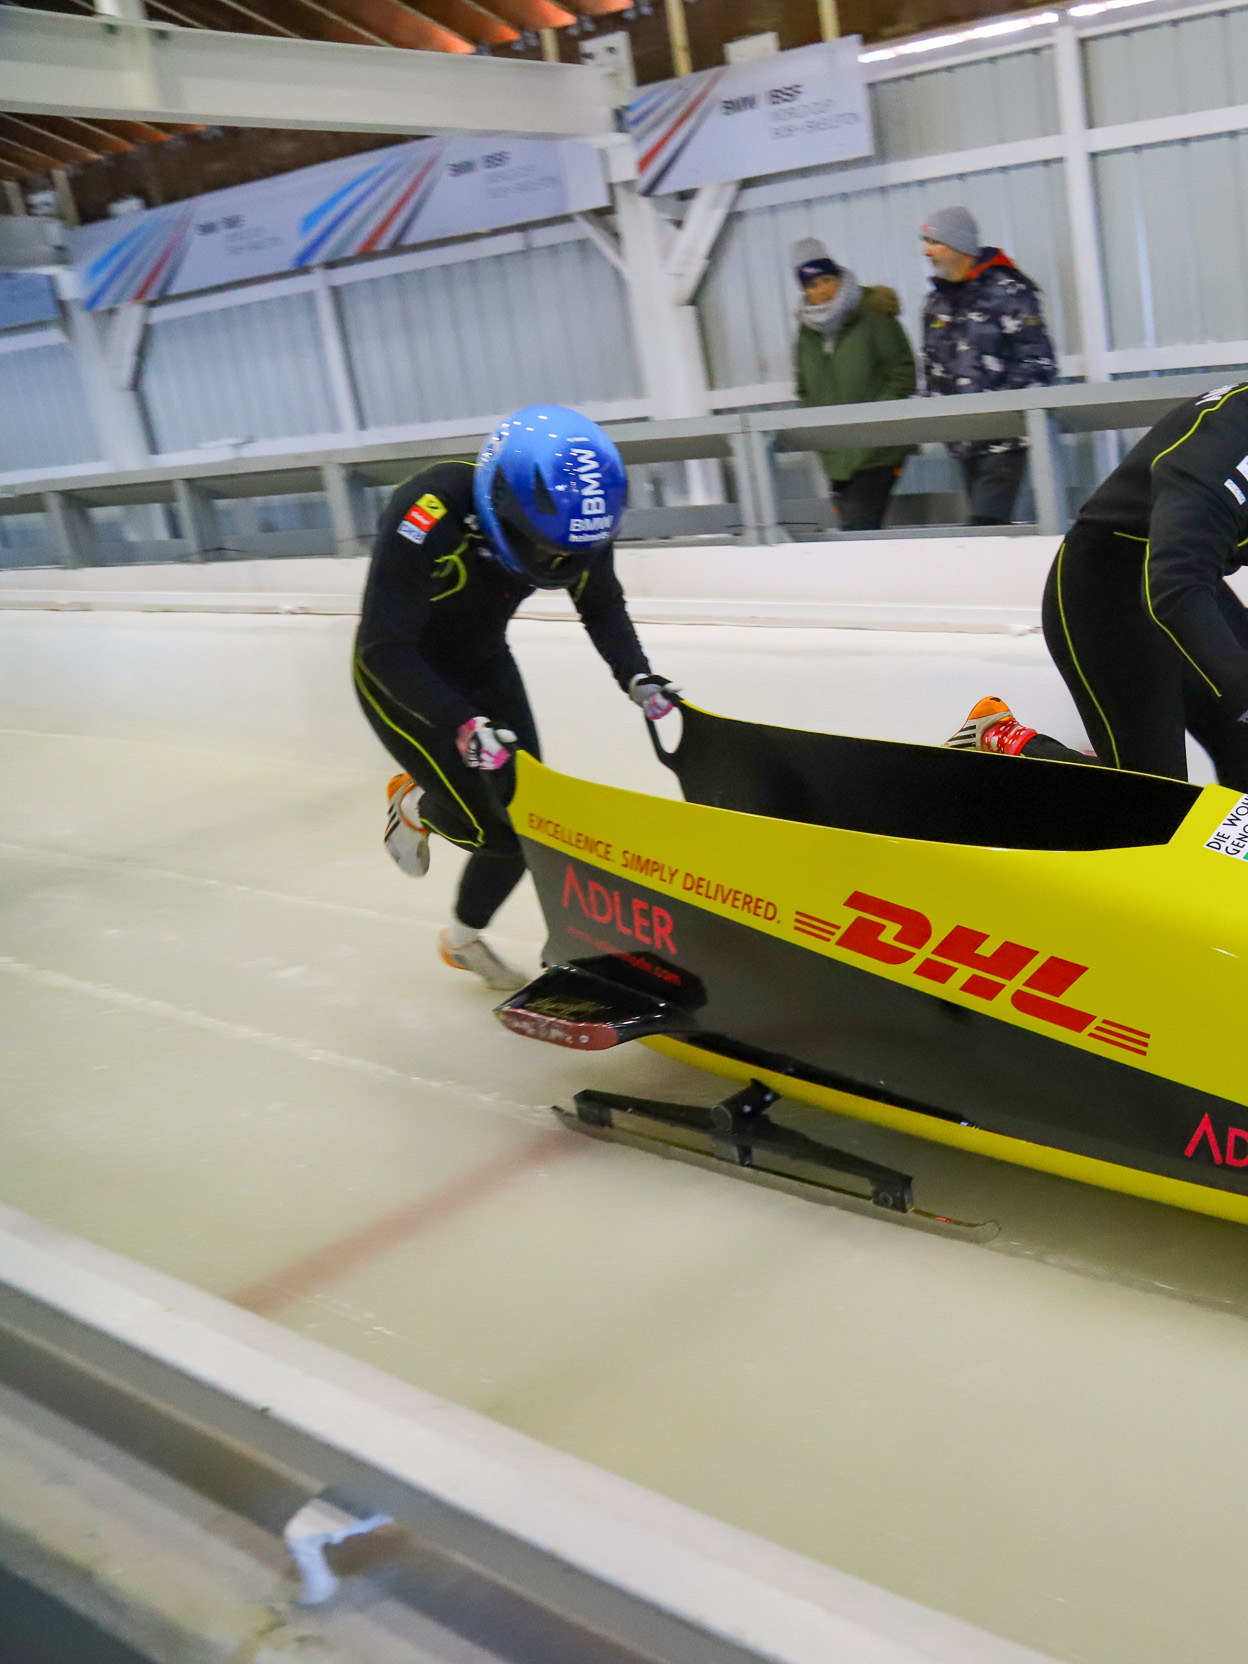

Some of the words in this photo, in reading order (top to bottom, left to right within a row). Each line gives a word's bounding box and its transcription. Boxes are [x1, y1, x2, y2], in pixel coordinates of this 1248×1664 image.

[570, 447, 606, 515] BMW
[527, 812, 615, 863] EXCELLENCE.
[620, 849, 680, 886] SIMPLY
[682, 872, 781, 924] DELIVERED.
[1205, 831, 1231, 851] DIE
[561, 863, 677, 955] ADLER
[834, 890, 1098, 1034] DHL
